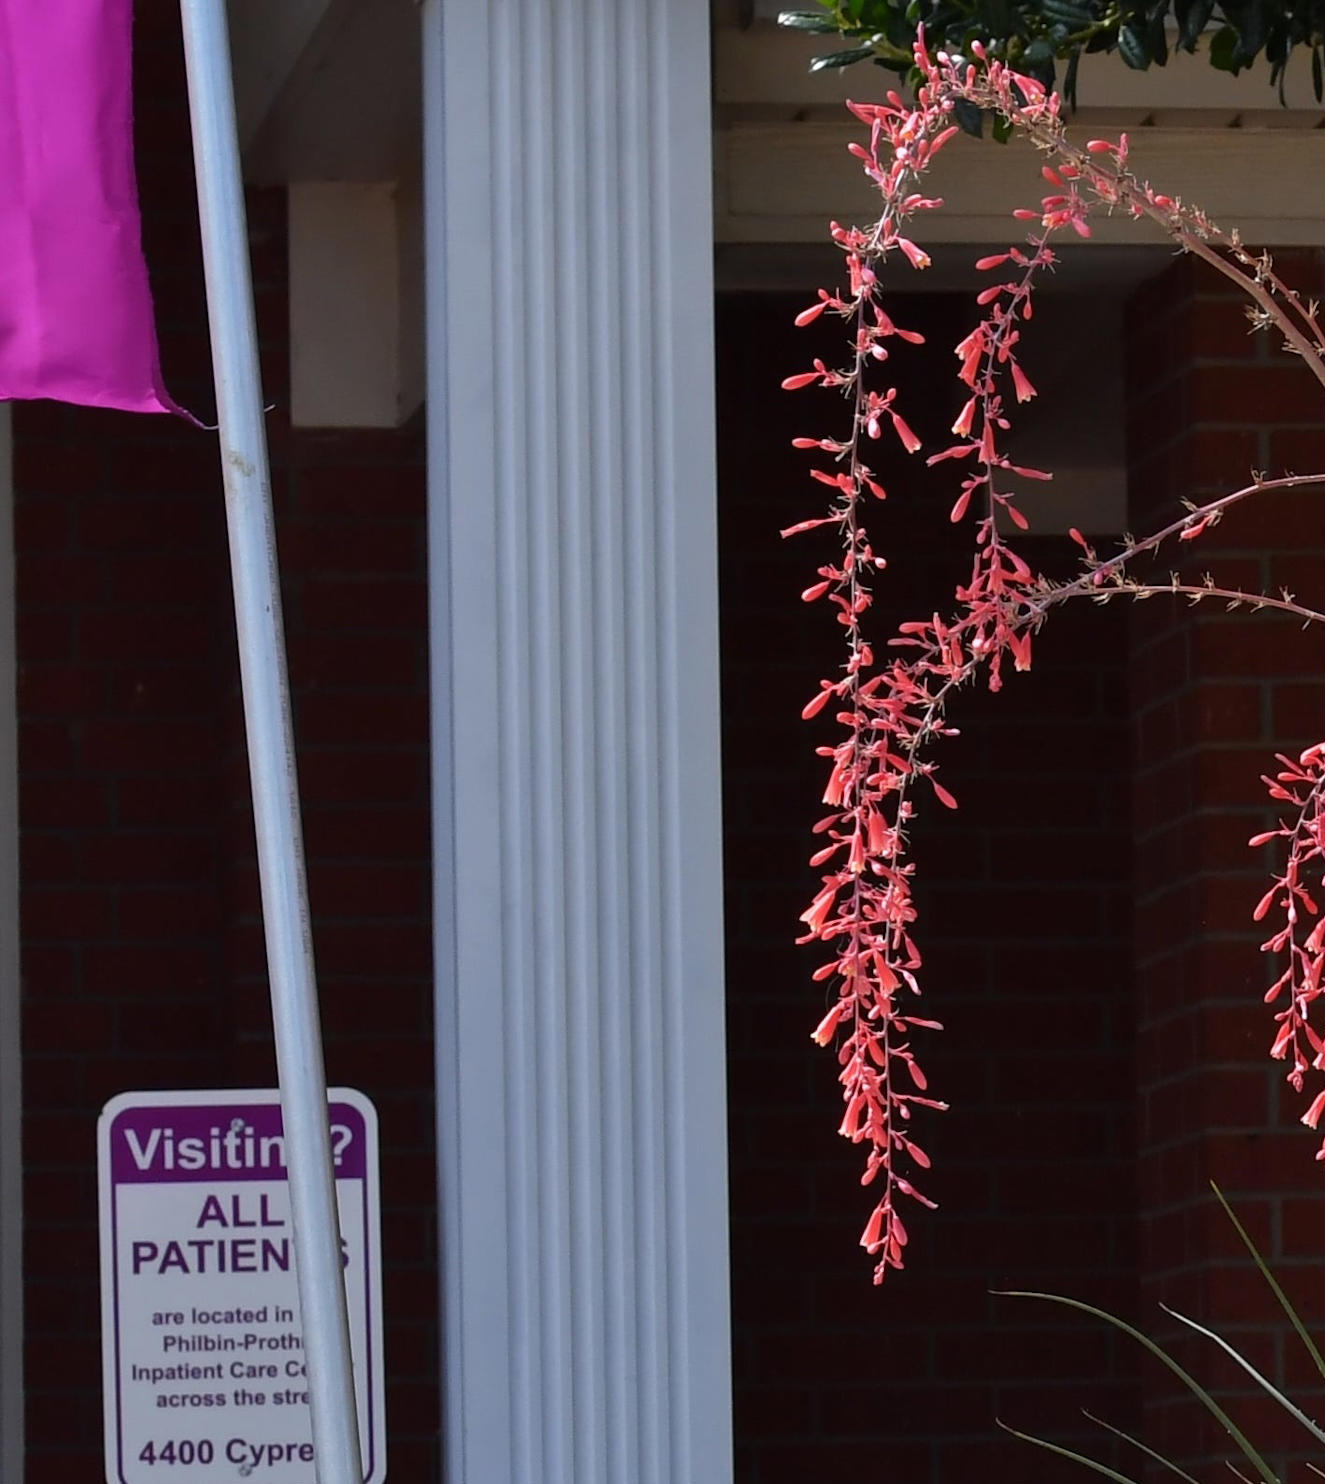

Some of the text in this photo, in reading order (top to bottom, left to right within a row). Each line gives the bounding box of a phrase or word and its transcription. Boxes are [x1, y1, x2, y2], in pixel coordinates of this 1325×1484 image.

[124, 1124, 352, 1171] Visitin?
[196, 1193, 286, 1229] ALL
[132, 1237, 349, 1275] PATIEN
[152, 1304, 294, 1326] are located in
[162, 1333, 305, 1353] Philbin-Proth
[131, 1362, 224, 1385] Inpatient
[229, 1361, 278, 1379] Care
[156, 1388, 310, 1409] across the stre
[138, 1437, 315, 1468] 4400 Cypre
